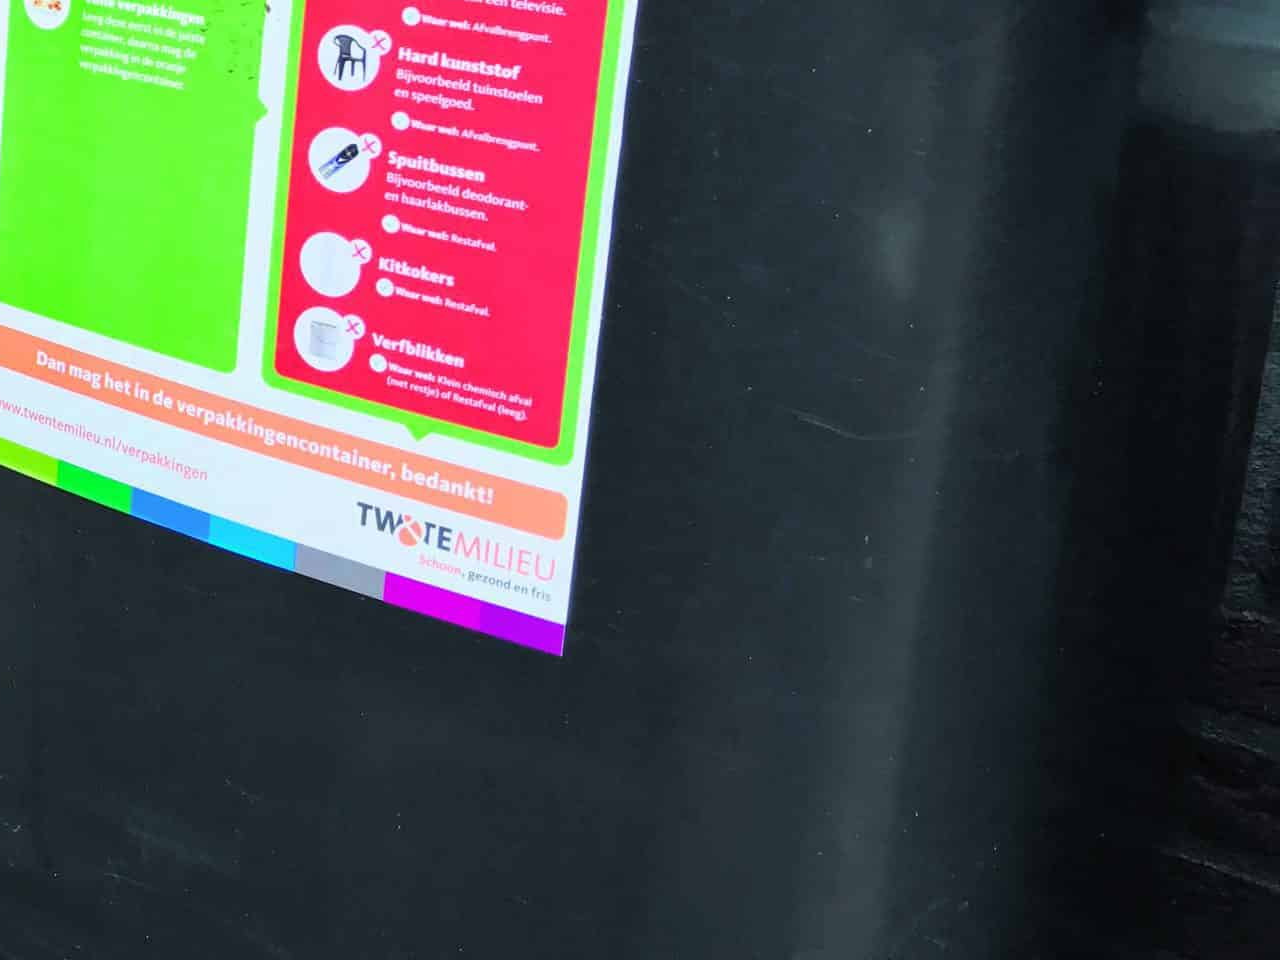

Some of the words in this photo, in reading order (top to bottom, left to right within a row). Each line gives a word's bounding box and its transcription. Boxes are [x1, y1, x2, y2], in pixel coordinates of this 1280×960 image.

[397, 46, 439, 68] Hard
[440, 52, 522, 81] kunststof
[393, 88, 410, 100] en
[411, 89, 475, 112] speelgoed.
[395, 67, 471, 93] Bijvoorbeeld
[472, 81, 544, 105] tuinstoelen
[388, 149, 486, 184] Spuitbussen
[386, 171, 460, 198] Bijvoorbeeld
[383, 191, 400, 204] en
[400, 191, 489, 222] haarlakbussen.
[378, 256, 456, 287] Kitkokers
[372, 332, 466, 369] Verfblikken
[441, 388, 452, 401] of
[452, 391, 497, 413] Restafval
[36, 348, 66, 374] Dan
[69, 364, 102, 390] mag
[104, 371, 132, 398] het
[133, 384, 150, 401] in
[152, 387, 173, 410] de
[176, 399, 397, 480] verpakkingencontainer,
[401, 462, 495, 506] bedankt!
[468, 570, 513, 591] gezond
[513, 583, 530, 596] en
[531, 586, 553, 603] fris
